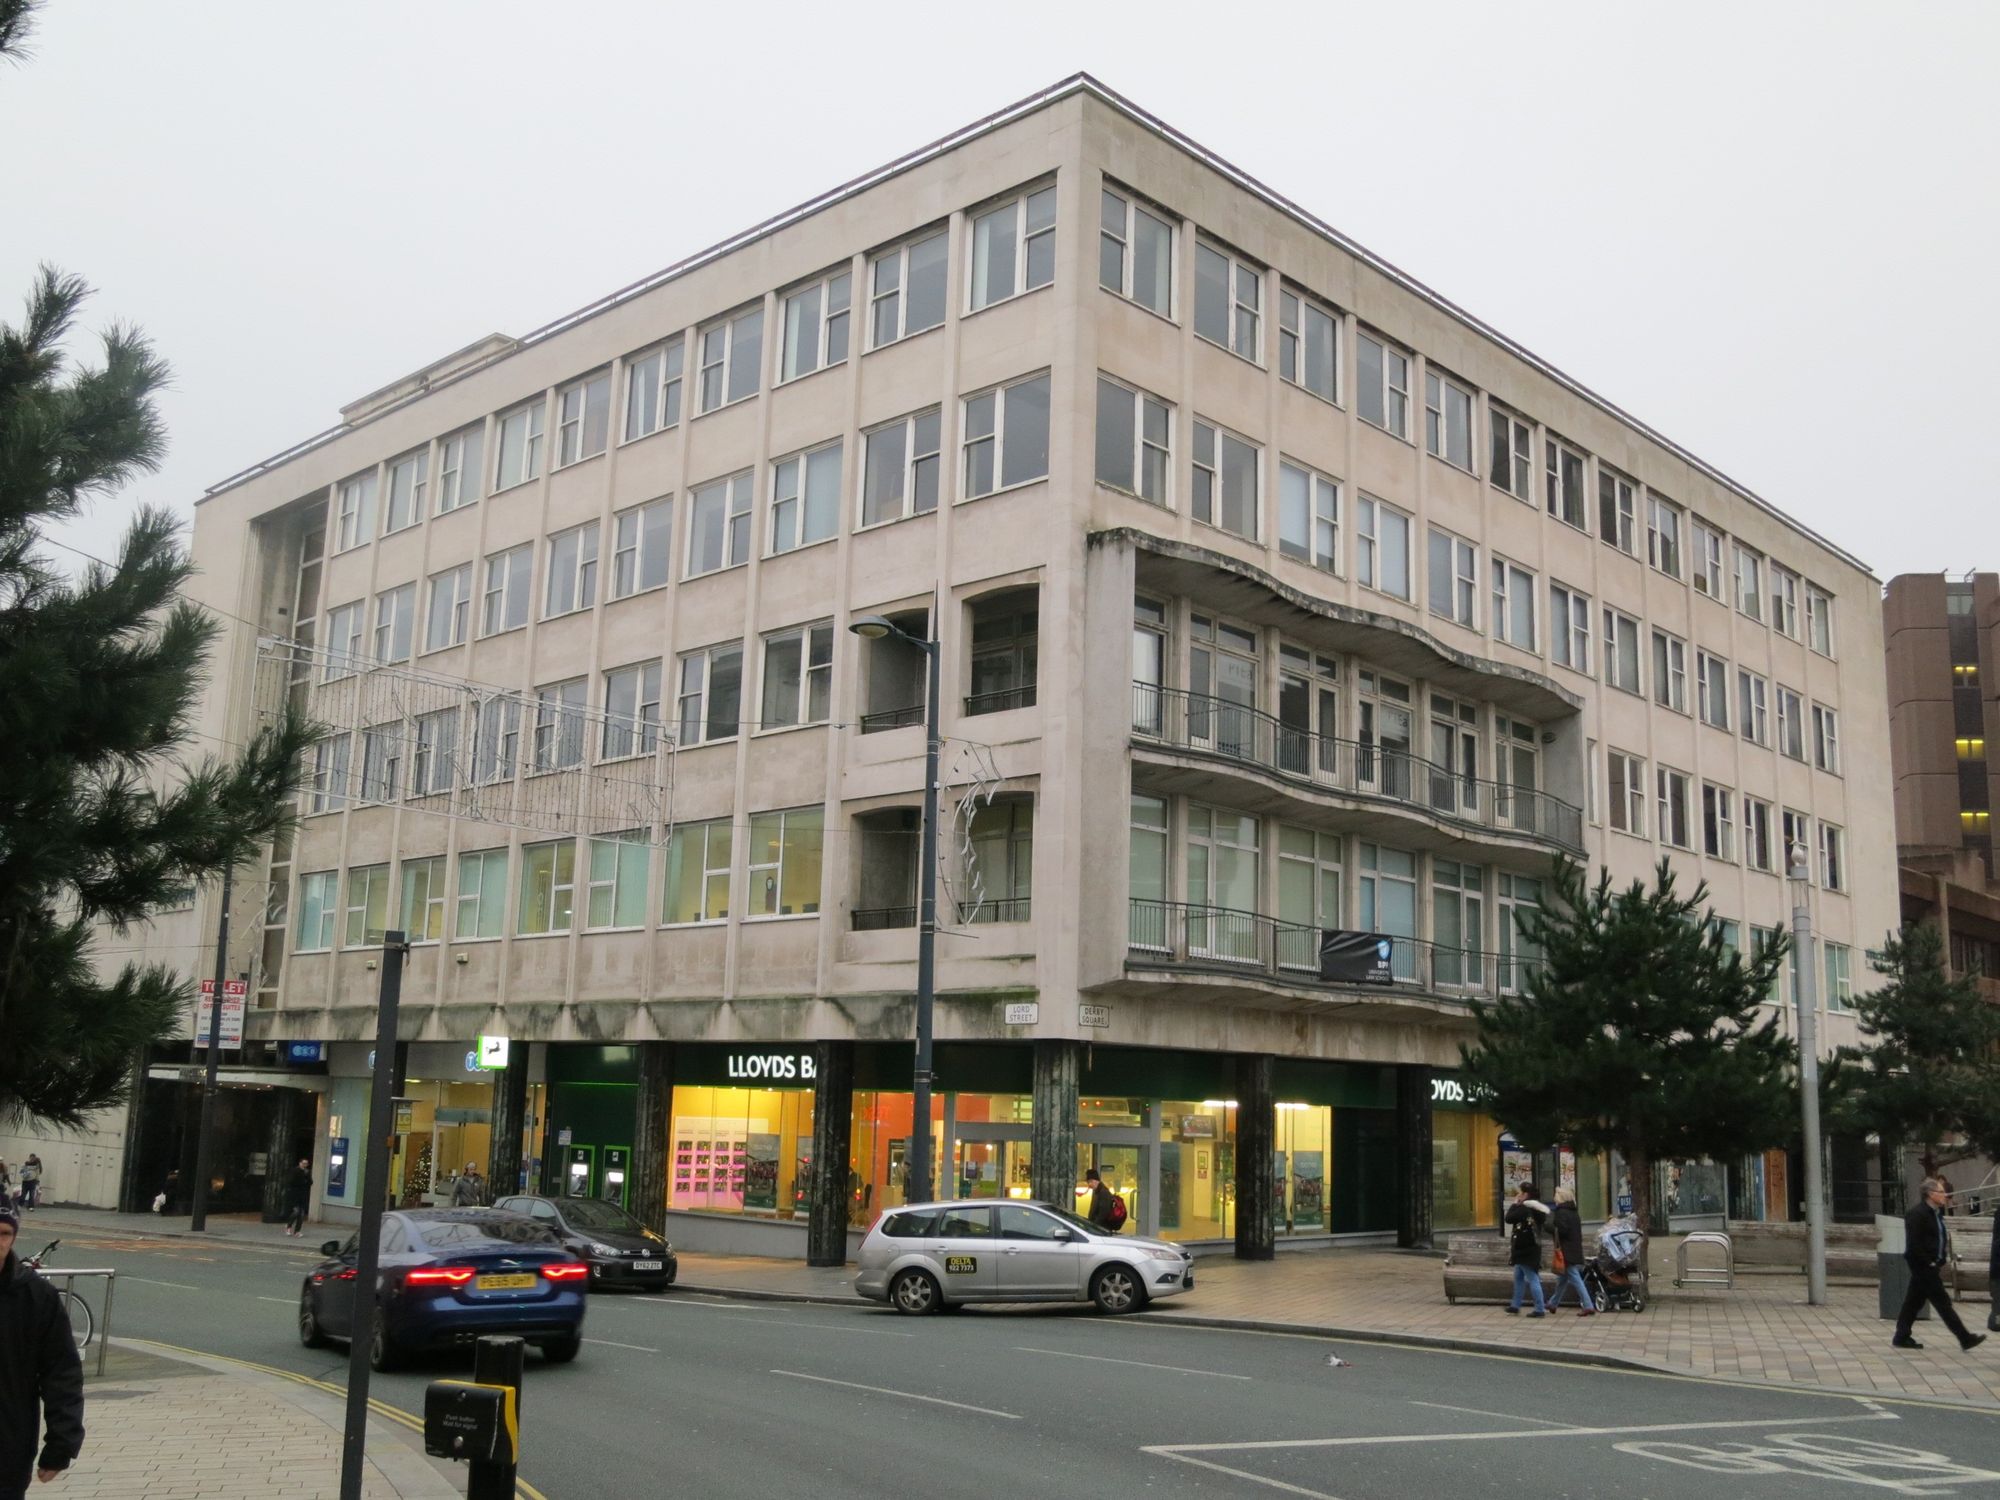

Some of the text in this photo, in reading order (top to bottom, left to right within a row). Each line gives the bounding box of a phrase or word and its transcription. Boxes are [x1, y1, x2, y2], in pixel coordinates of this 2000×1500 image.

[1013, 1005, 1030, 1013] LORD
[1084, 1007, 1104, 1015] DERBY
[1009, 1014, 1032, 1022] STREET
[1082, 1015, 1105, 1024] SQUARE
[728, 1055, 796, 1078] LLOYDS
[950, 1257, 972, 1265] DELTA
